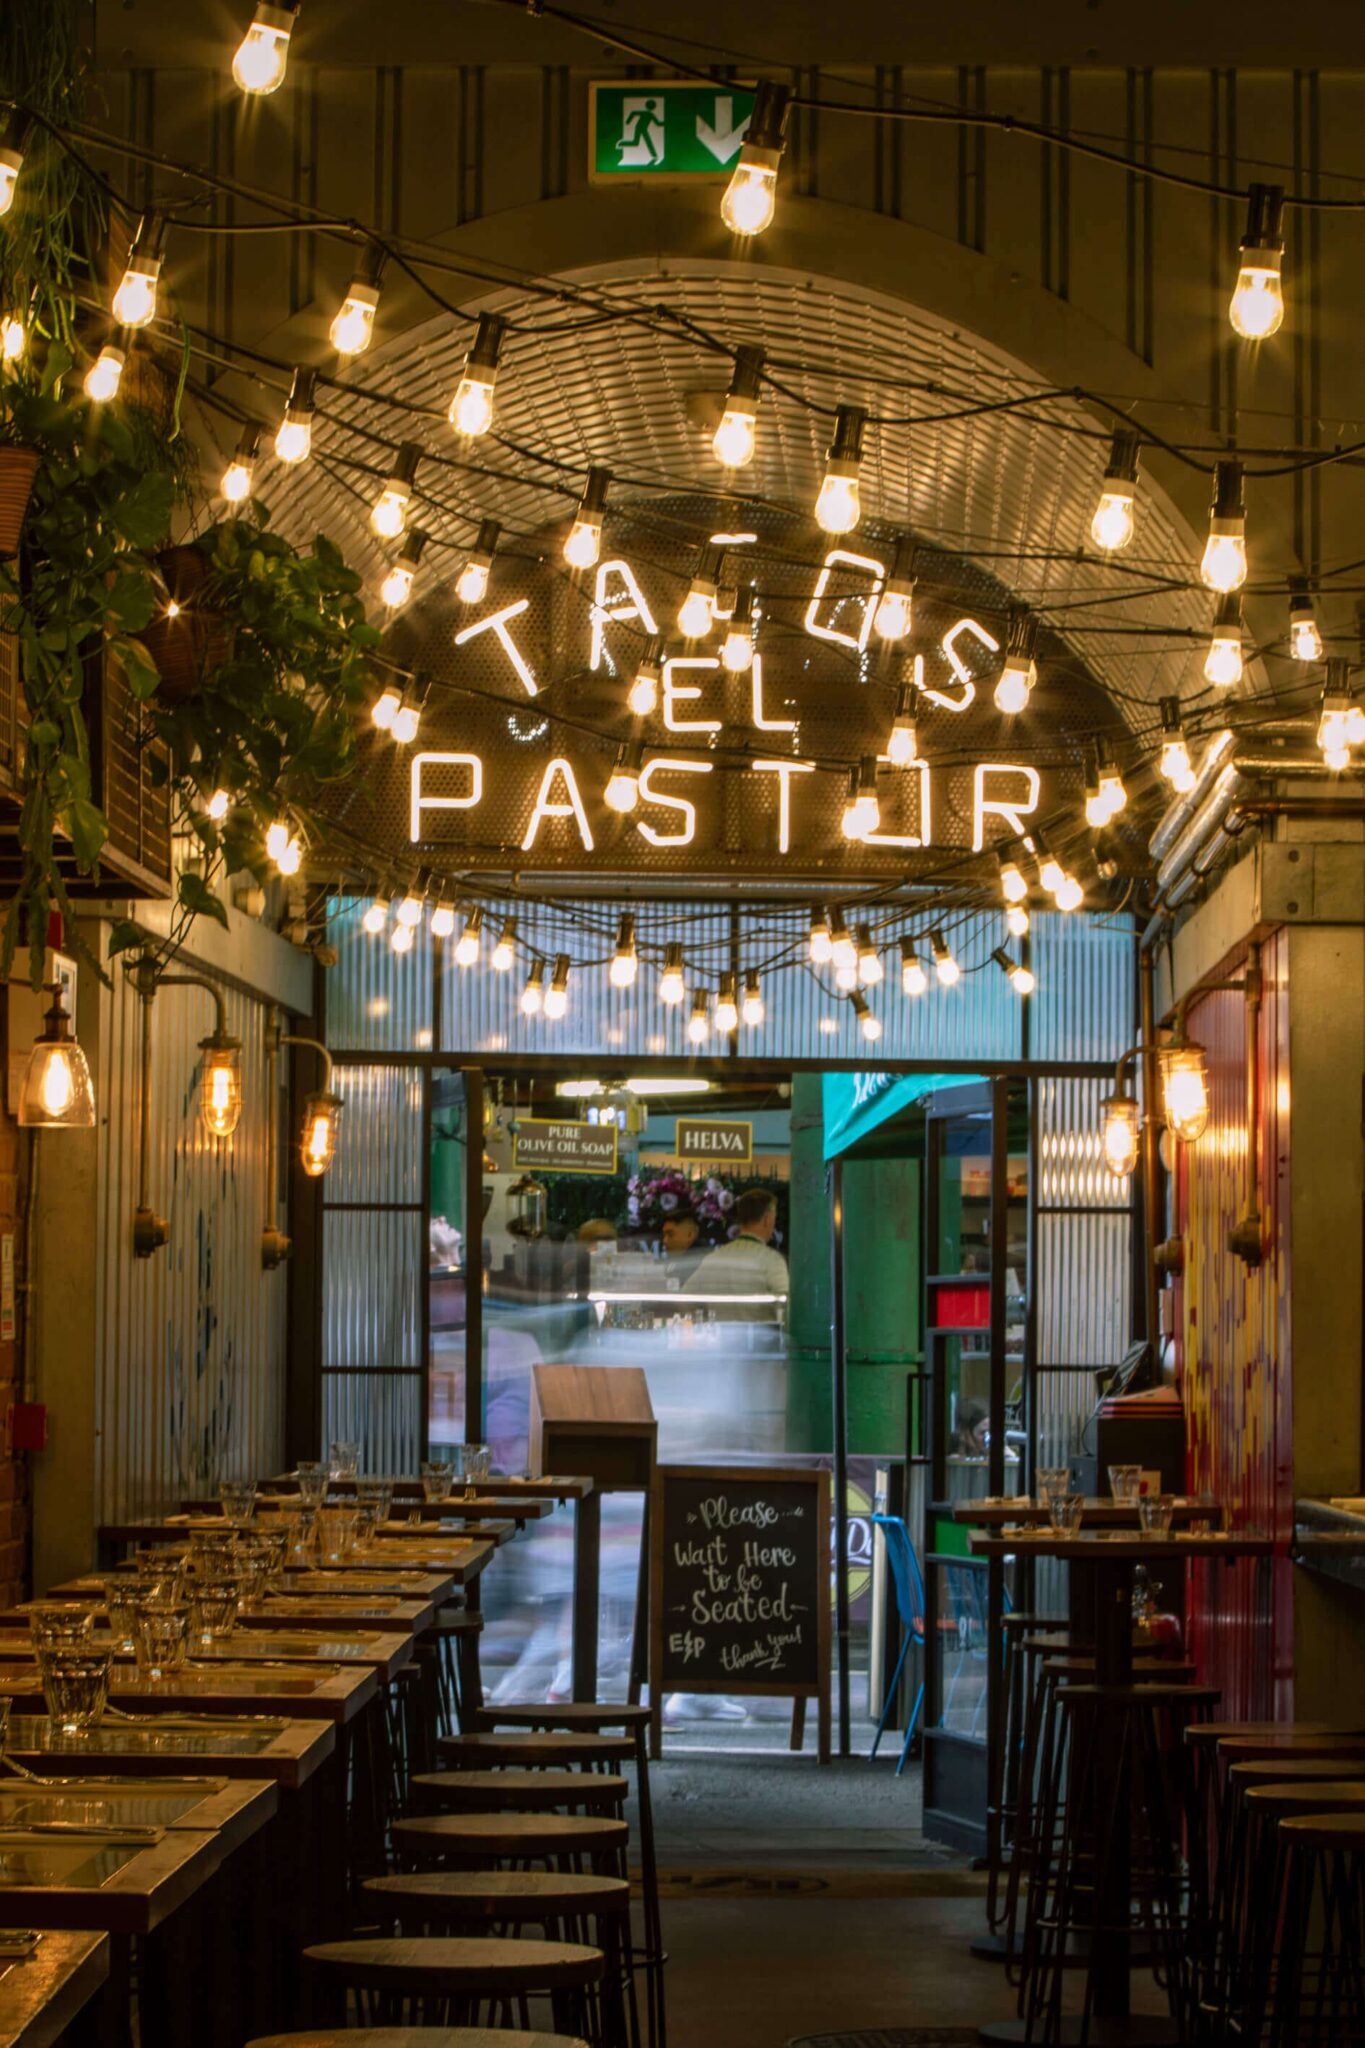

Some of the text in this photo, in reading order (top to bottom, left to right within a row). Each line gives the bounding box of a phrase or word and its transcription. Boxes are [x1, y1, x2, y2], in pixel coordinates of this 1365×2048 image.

[663, 655, 799, 732] EL
[517, 1139, 614, 1156] OLIVE OIL SOAP
[548, 1125, 582, 1140] PURE
[684, 1130, 745, 1152] HELVA
[699, 1495, 779, 1530] Please
[673, 1535, 728, 1567] Wait
[743, 1541, 796, 1568] Here
[702, 1563, 763, 1593] to be
[691, 1581, 793, 1625] Seated
